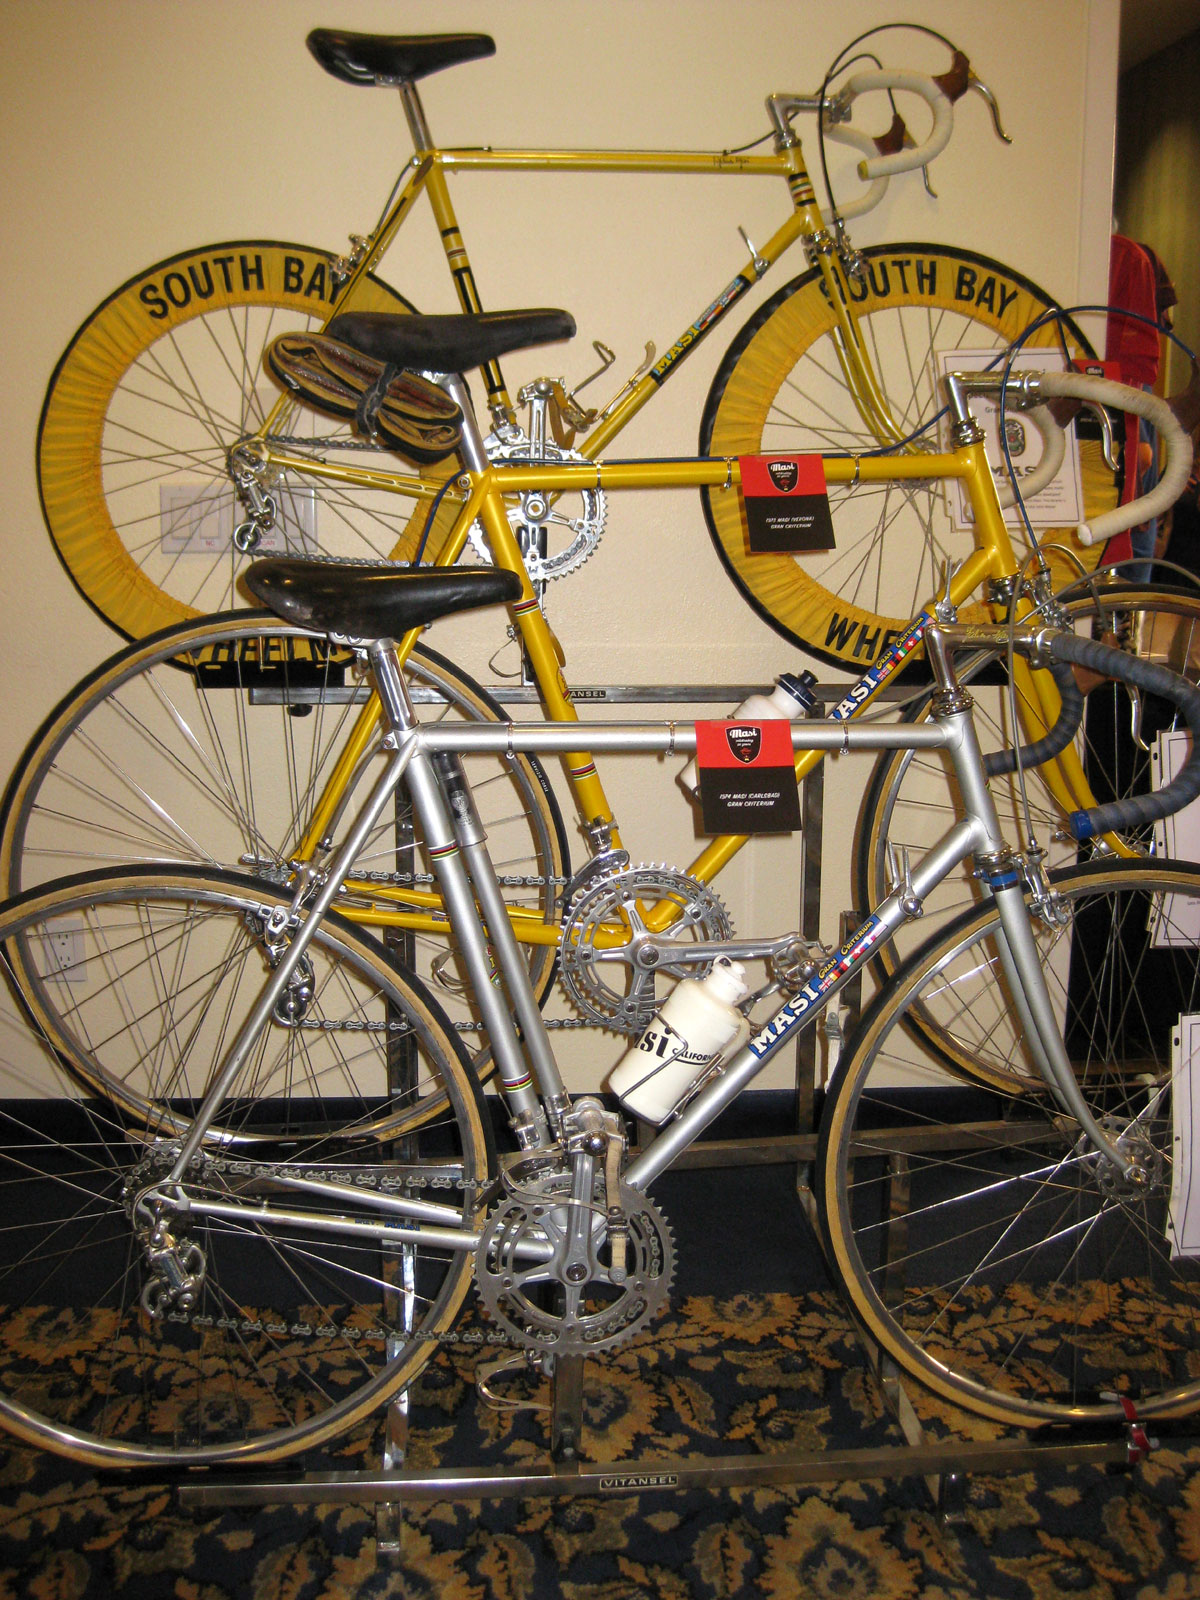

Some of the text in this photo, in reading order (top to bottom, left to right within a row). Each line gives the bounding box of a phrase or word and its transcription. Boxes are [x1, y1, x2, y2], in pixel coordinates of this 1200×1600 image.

[139, 254, 265, 319] SOUTH
[955, 265, 1018, 319] BAY
[656, 325, 700, 375] MASI
[828, 674, 877, 720] ASI
[729, 728, 758, 738] Masi
[751, 983, 819, 1054] MASI
[604, 1476, 676, 1487] VITANSEL
